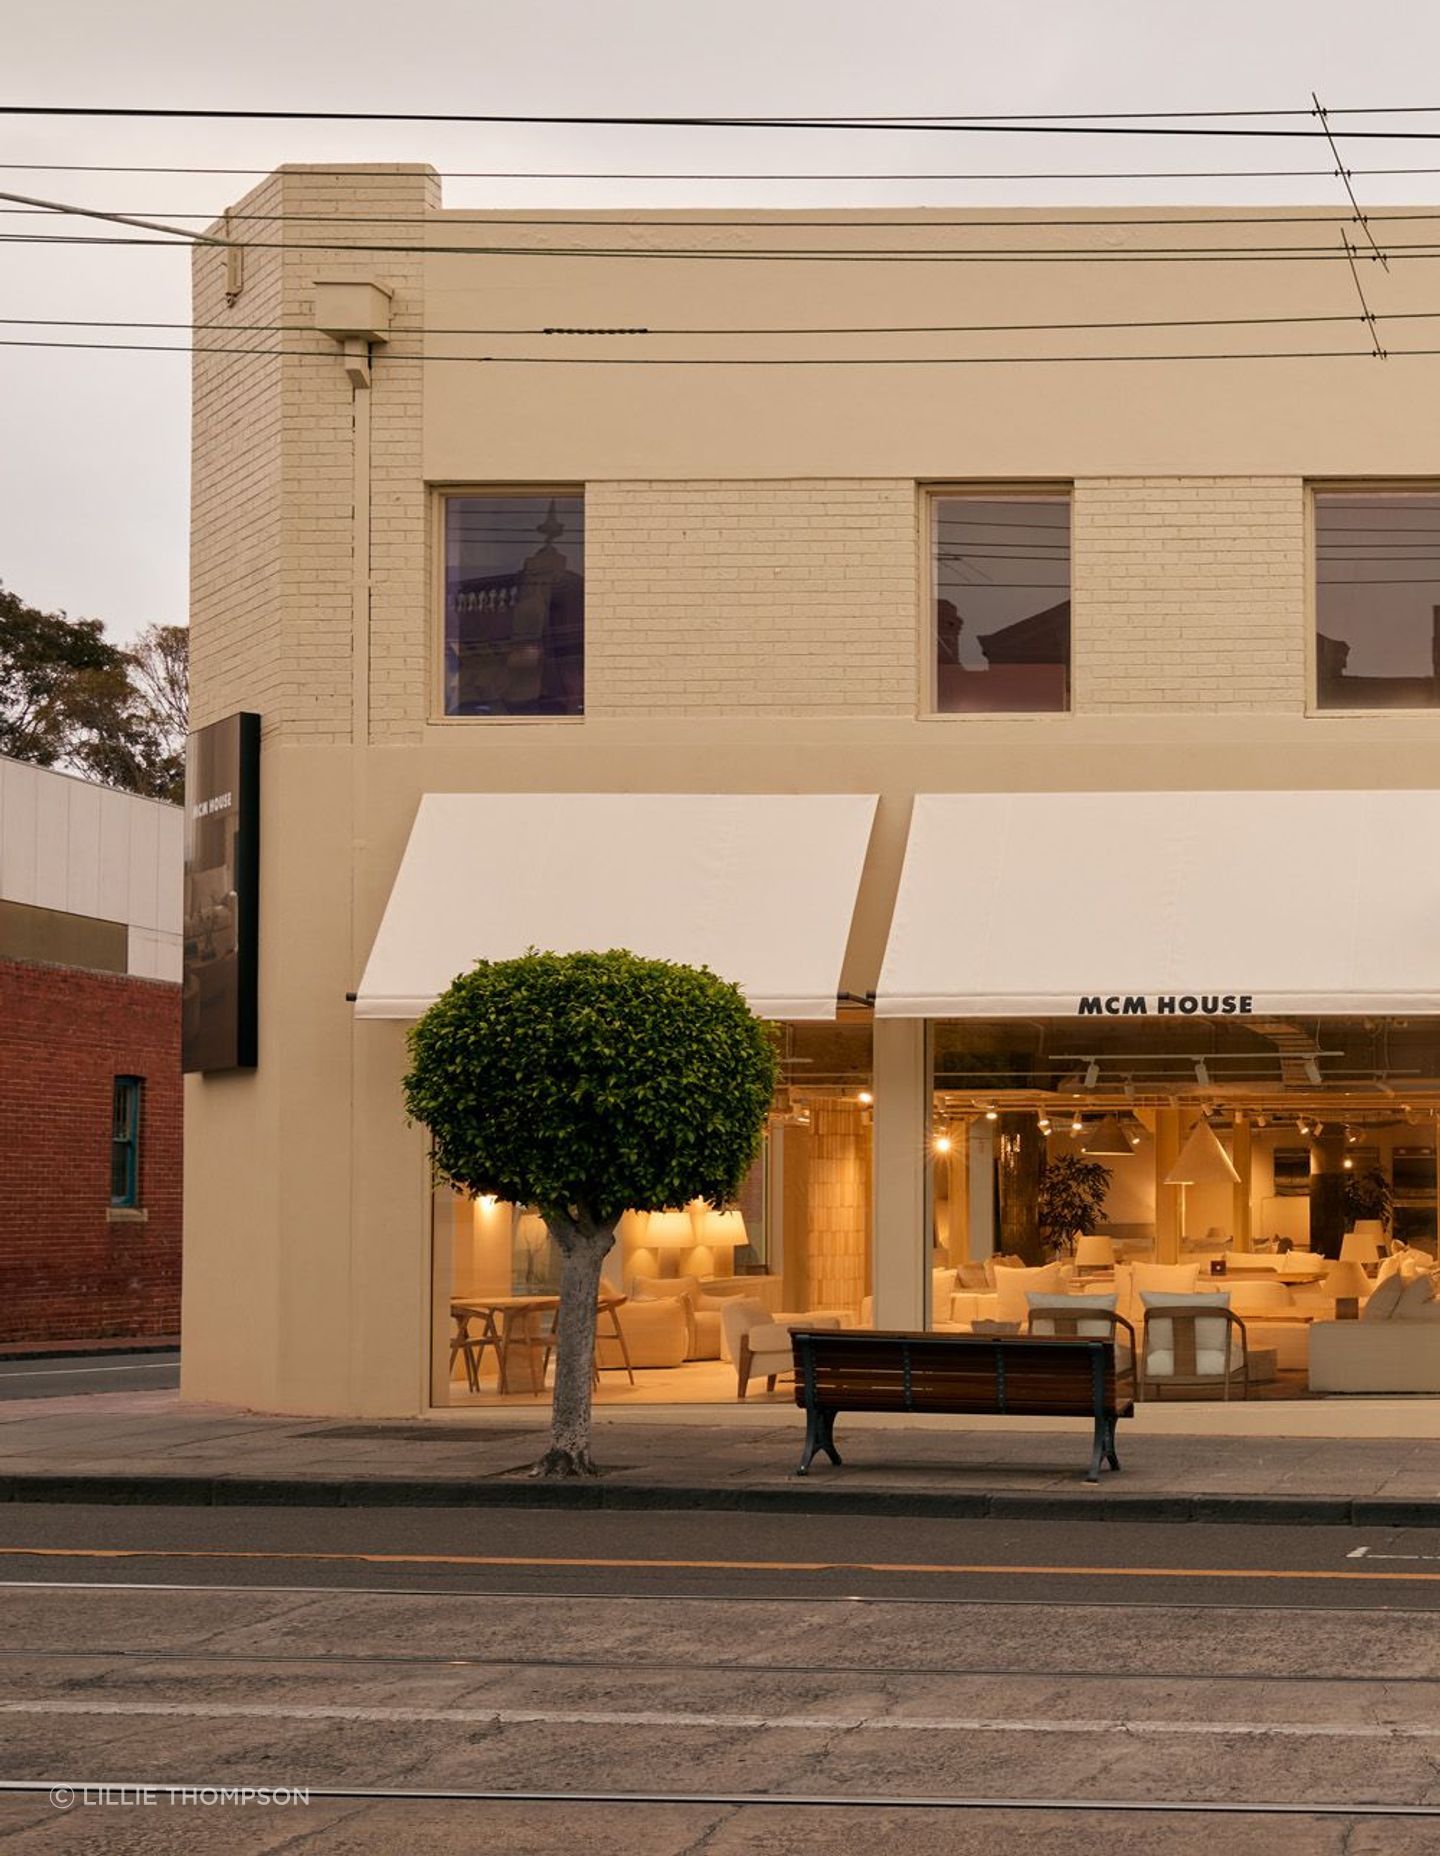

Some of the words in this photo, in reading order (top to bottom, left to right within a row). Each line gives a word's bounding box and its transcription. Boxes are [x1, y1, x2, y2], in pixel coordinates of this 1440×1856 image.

[209, 791, 232, 813] HOUSE
[1078, 997, 1147, 1014] MCM
[1157, 996, 1252, 1014] HOUSE
